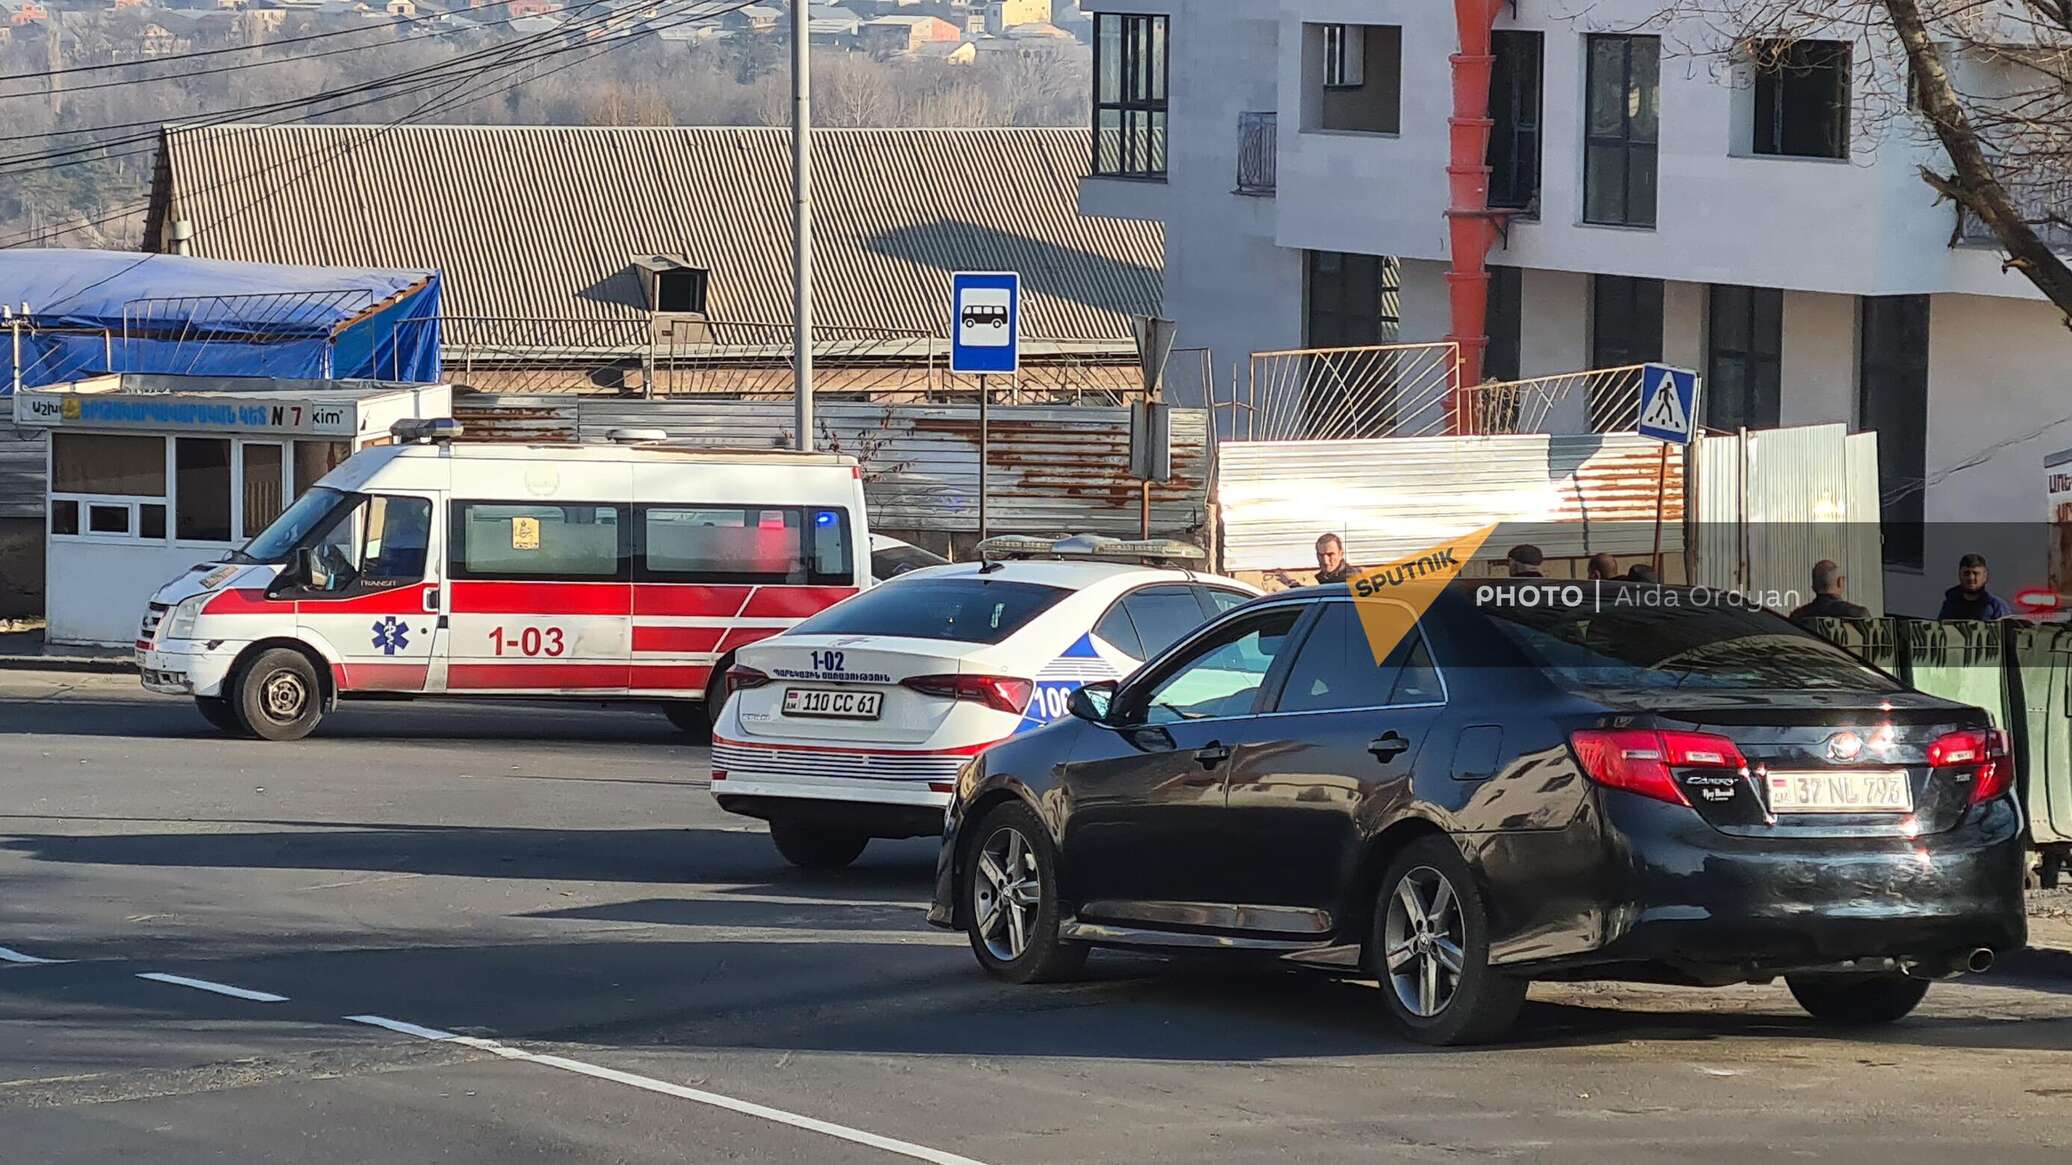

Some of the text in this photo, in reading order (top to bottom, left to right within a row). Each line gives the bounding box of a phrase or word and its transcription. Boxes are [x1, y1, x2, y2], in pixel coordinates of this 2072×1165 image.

[271, 406, 284, 426] N
[290, 406, 303, 426] 7
[489, 626, 565, 657] 1-03
[811, 651, 844, 671] 1-02
[803, 693, 875, 713] 110 CC 61
